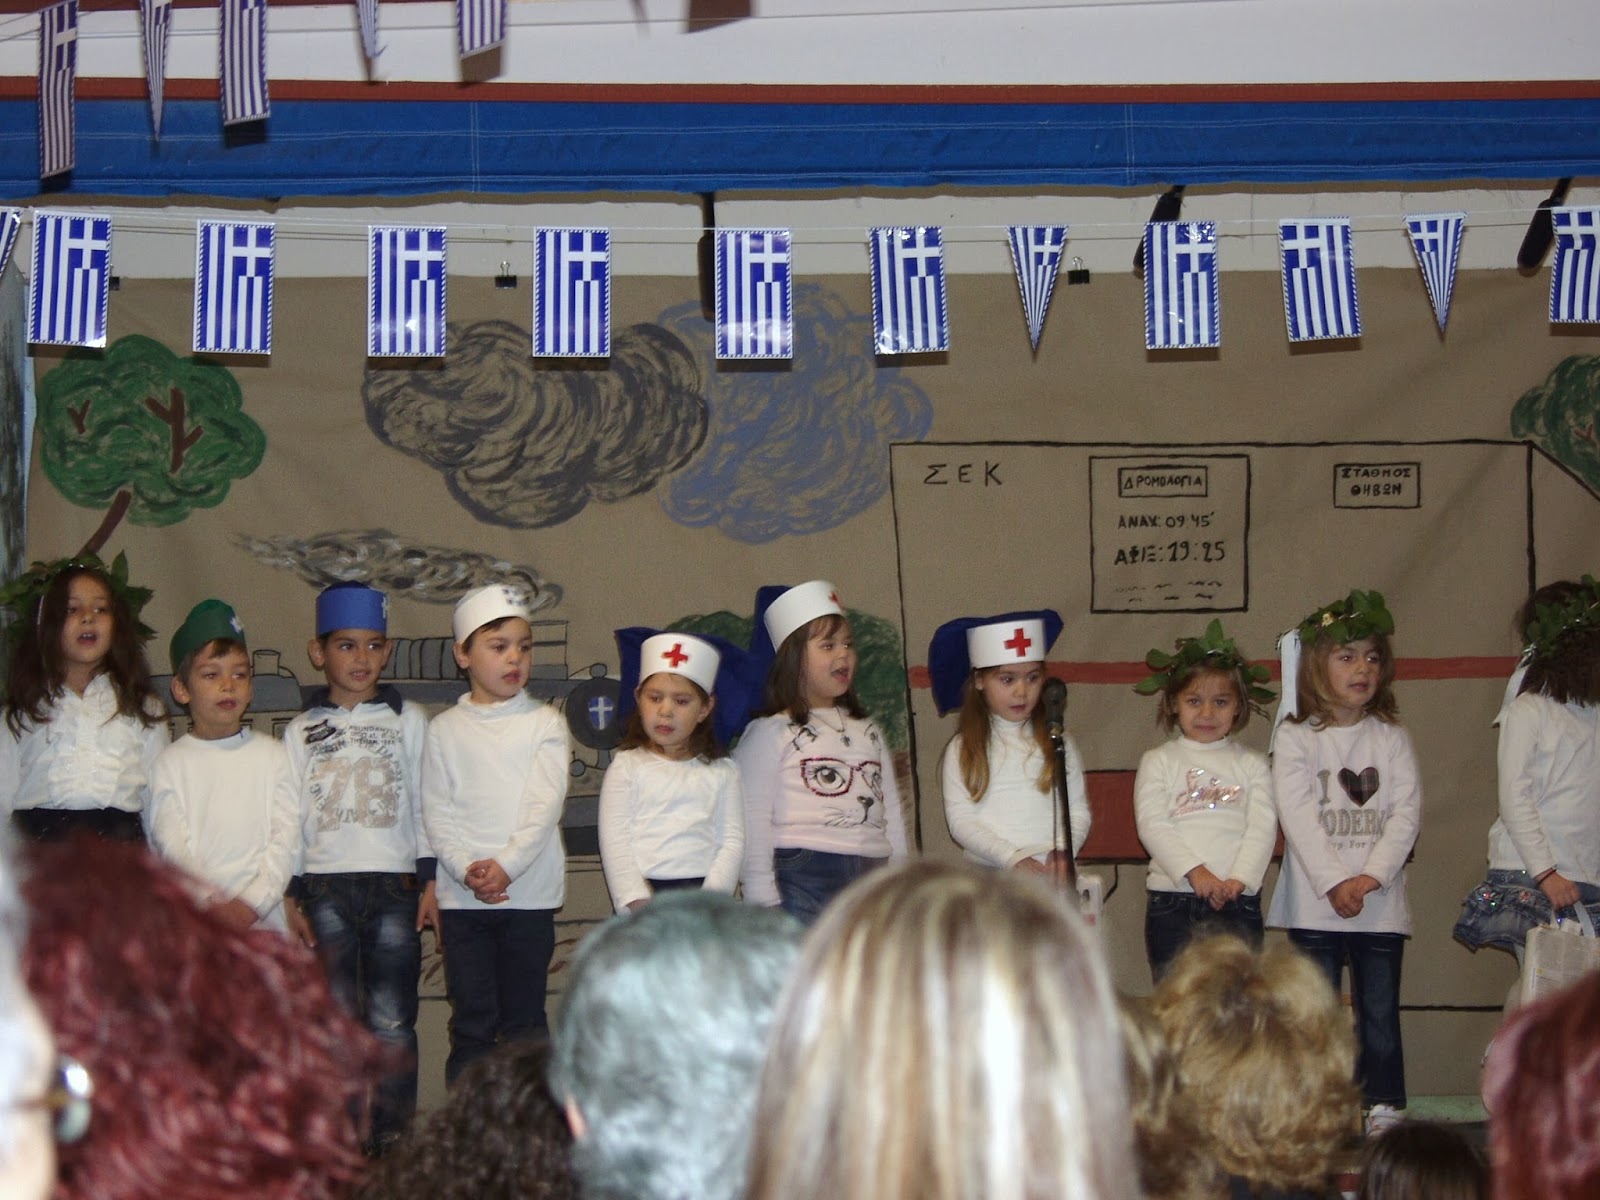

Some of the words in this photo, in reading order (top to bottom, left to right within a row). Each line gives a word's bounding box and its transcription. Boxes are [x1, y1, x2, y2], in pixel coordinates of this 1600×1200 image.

[923, 460, 1002, 487] ΣΕΚ
[1341, 467, 1411, 478] ΣΤΑΘΜΟΣ
[1123, 475, 1202, 490] ΔΡΟΜΟΛΟΓΙΑ
[1350, 483, 1402, 496] ΘΗΒΩΝ
[1167, 540, 1226, 563] 19:25
[315, 756, 398, 832] 78
[1317, 769, 1331, 806] I
[1349, 840, 1366, 849] For
